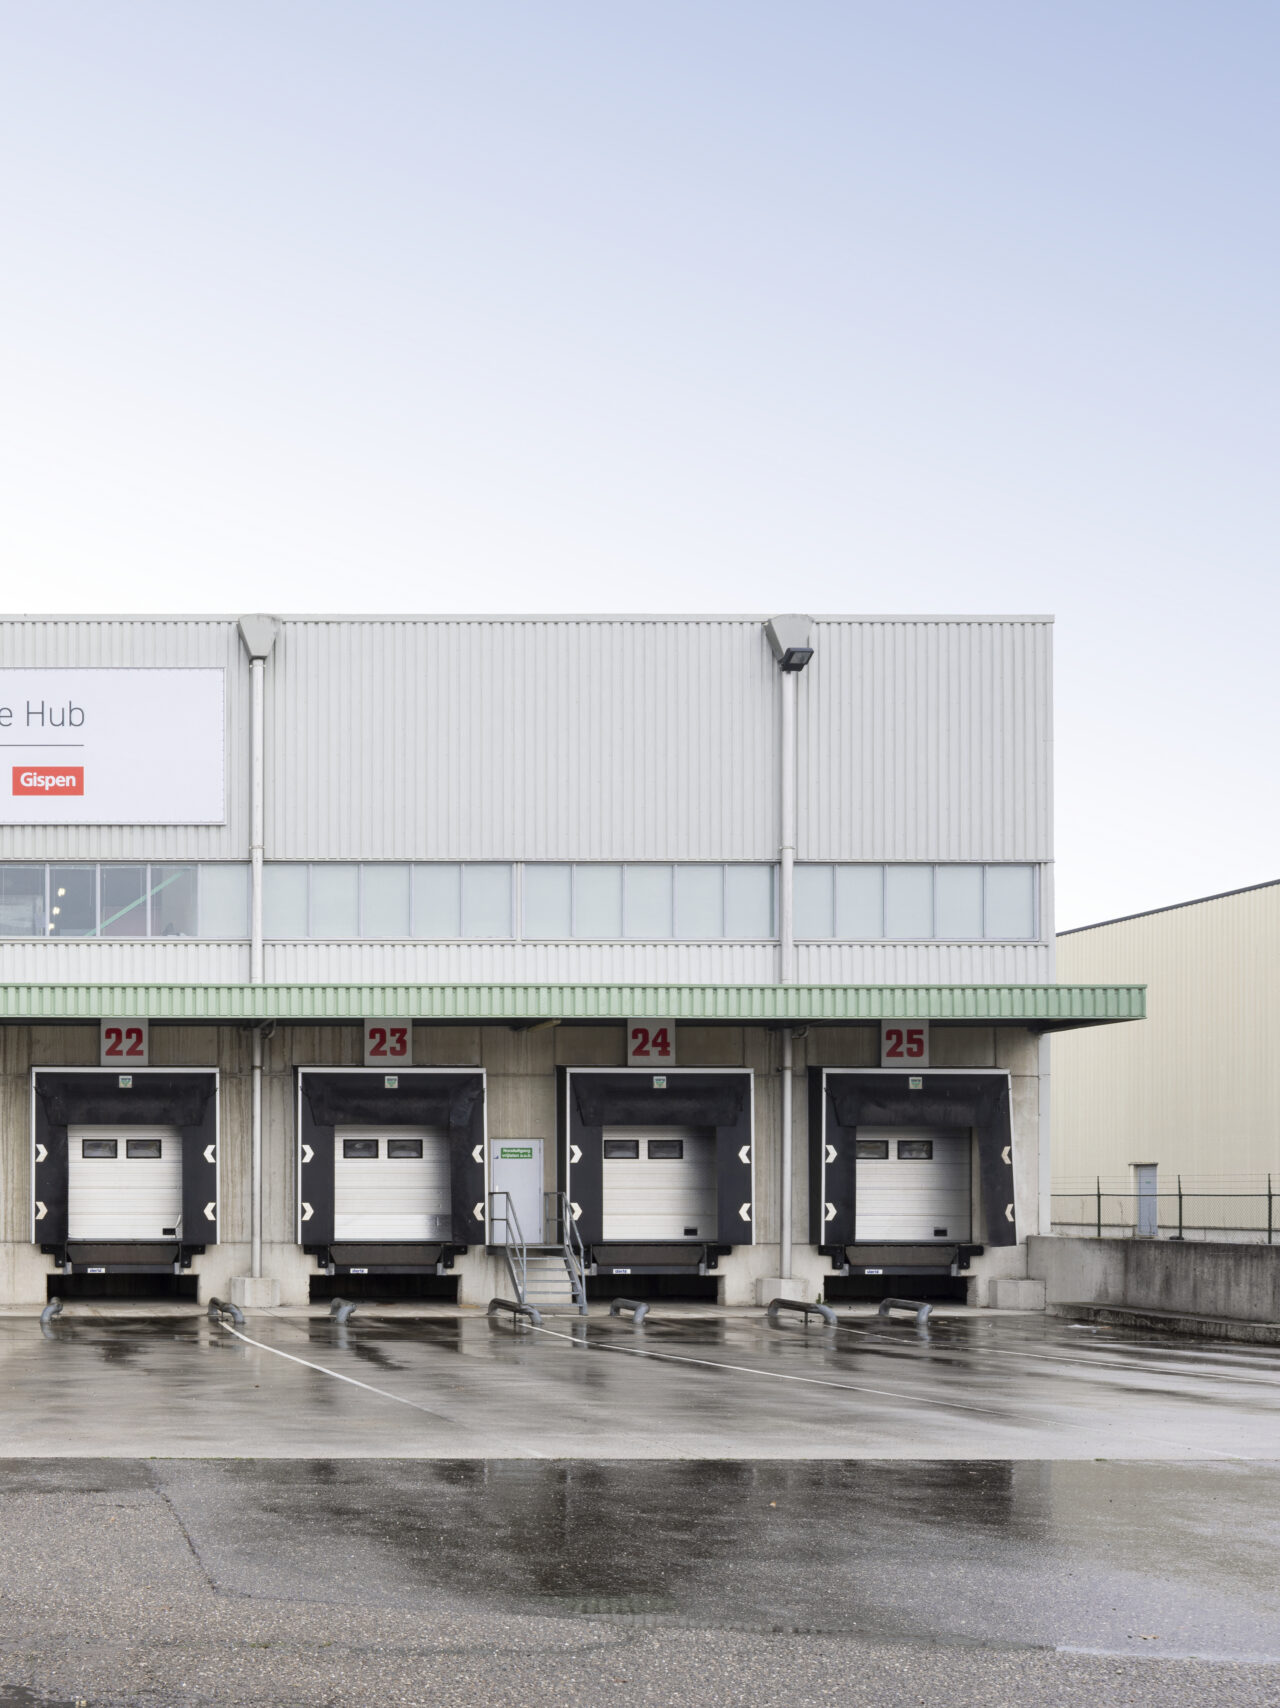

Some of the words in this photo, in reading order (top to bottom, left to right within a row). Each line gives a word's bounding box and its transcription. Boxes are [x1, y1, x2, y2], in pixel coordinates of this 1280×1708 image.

[26, 700, 85, 728] Hub
[19, 771, 77, 791] Gispen
[105, 1028, 144, 1057] 22
[369, 1028, 408, 1057] 23
[631, 1028, 670, 1057] 24
[885, 1029, 924, 1057] 25
